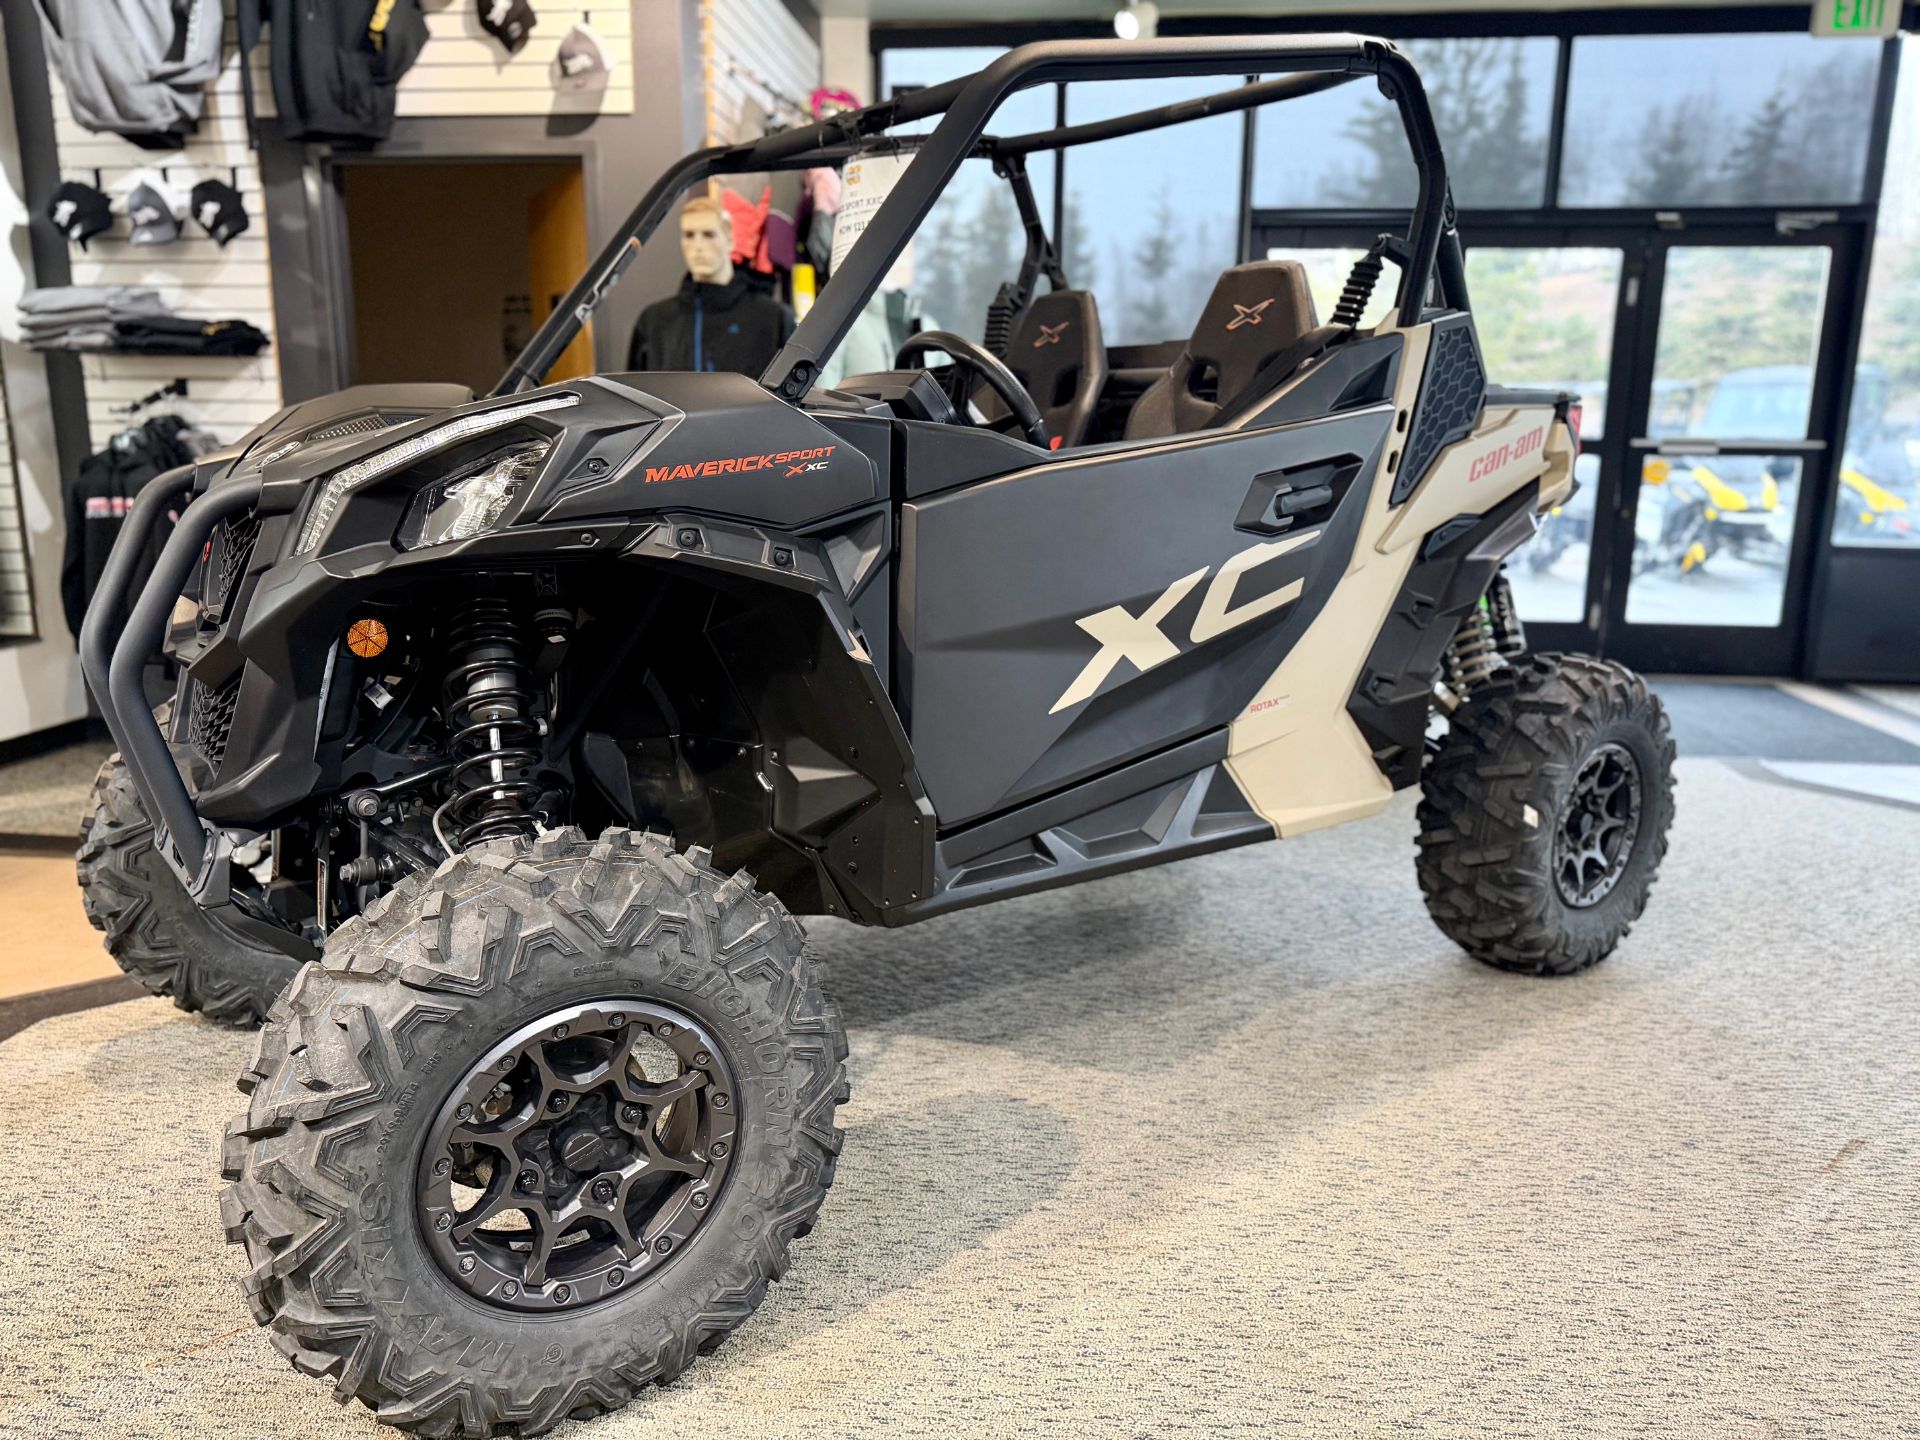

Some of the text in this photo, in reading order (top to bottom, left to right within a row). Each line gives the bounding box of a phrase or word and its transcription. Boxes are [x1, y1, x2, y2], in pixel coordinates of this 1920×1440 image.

[645, 446, 837, 484] MAVERICK SPORT
[1468, 425, 1543, 483] can-am
[1047, 529, 1321, 715] XC
[1250, 697, 1280, 713] ROTAX
[660, 961, 794, 1148] BIGHORN
